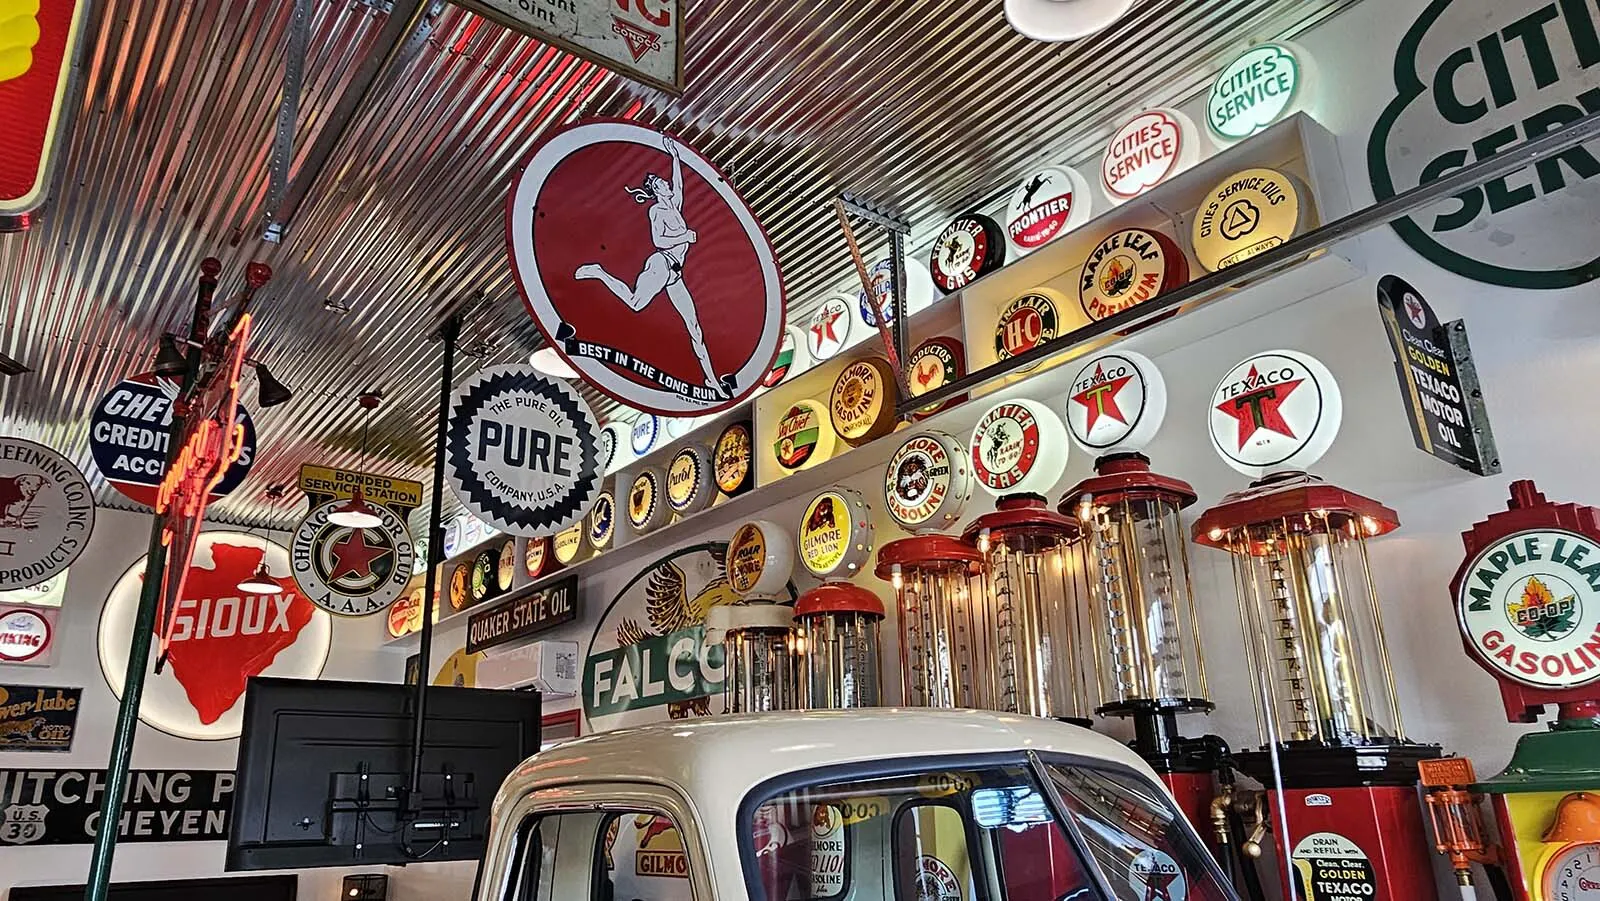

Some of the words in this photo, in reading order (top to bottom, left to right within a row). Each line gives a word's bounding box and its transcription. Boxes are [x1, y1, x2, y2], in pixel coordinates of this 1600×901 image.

[509, 0, 555, 25] oint
[612, 23, 661, 51] CONOCO
[1219, 55, 1277, 99] CITIES
[1433, 0, 1600, 125] CITI
[1215, 72, 1290, 127] SERVICE
[1113, 121, 1162, 159] CITIES
[1109, 138, 1173, 185] SERVICE
[1419, 86, 1600, 232] SER
[1010, 198, 1069, 239] FRONTIER
[1201, 202, 1219, 238] CITIES
[1218, 177, 1265, 202] SERVICE
[1261, 181, 1286, 206] OILS
[932, 219, 984, 260] FRONTIER
[1247, 240, 1275, 256] ALWAYS
[946, 265, 977, 290] GAS
[1083, 235, 1120, 291] MAPLE
[1123, 232, 1159, 260] LEAF
[1089, 273, 1159, 318] PREMIUM
[812, 304, 842, 323] TEXACO
[996, 297, 1050, 337] SINCLAIR
[578, 342, 611, 361] BEST
[615, 352, 629, 367] IN
[632, 358, 655, 380] THE
[657, 373, 689, 395] LONG
[692, 385, 717, 400] RUN
[910, 345, 952, 368] ODUCTOS
[1407, 345, 1451, 377] GOLDEN
[837, 365, 873, 394] GILMORE
[1075, 366, 1127, 393] TEXACO
[1221, 367, 1295, 400] TEXACO
[1410, 364, 1461, 404] TEXACO
[489, 399, 513, 416] THE
[516, 397, 548, 413] PURE
[548, 409, 565, 429] OIL
[835, 388, 874, 422] GASOLINE
[1419, 391, 1465, 428] MOTOR
[633, 422, 651, 439] PURE
[973, 405, 1035, 447] FRONTIER
[1437, 422, 1462, 449] OIL
[0, 444, 73, 483] EFINING
[477, 418, 573, 478] PURE
[888, 438, 945, 479] GILMORE
[305, 478, 361, 494] SERVICE
[365, 486, 417, 503] STATION
[335, 471, 392, 489] BONDED
[484, 470, 537, 503] COMPANY,
[538, 483, 566, 501] U.S.A.
[988, 465, 1025, 488] GAS
[889, 482, 946, 521] GASOLINE
[366, 503, 404, 539] OTOR
[393, 541, 413, 585] CLUB
[803, 528, 842, 551] GILMORE
[821, 542, 840, 556] LION
[0, 536, 78, 584] PRODUCTS
[1469, 537, 1542, 612] MAPLE
[1550, 537, 1600, 592] LEA
[170, 593, 296, 642] SIOUX
[470, 610, 509, 646] QUAKER
[512, 599, 546, 631] STATE
[551, 587, 571, 616] OIL
[1482, 622, 1600, 678] GASOLIN
[593, 636, 727, 708] FALCO
[13, 810, 41, 821] U.S.
[84, 809, 227, 836] CHEYEN
[1312, 838, 1338, 846] DRAIN
[1313, 847, 1342, 855] REFILL
[640, 854, 687, 874] GILMO
[1319, 869, 1366, 880] GOLDEN
[1564, 868, 1573, 878] 3
[1573, 860, 1582, 870] 2
[1316, 881, 1373, 896] TEXACO
[1561, 880, 1569, 888] 4
